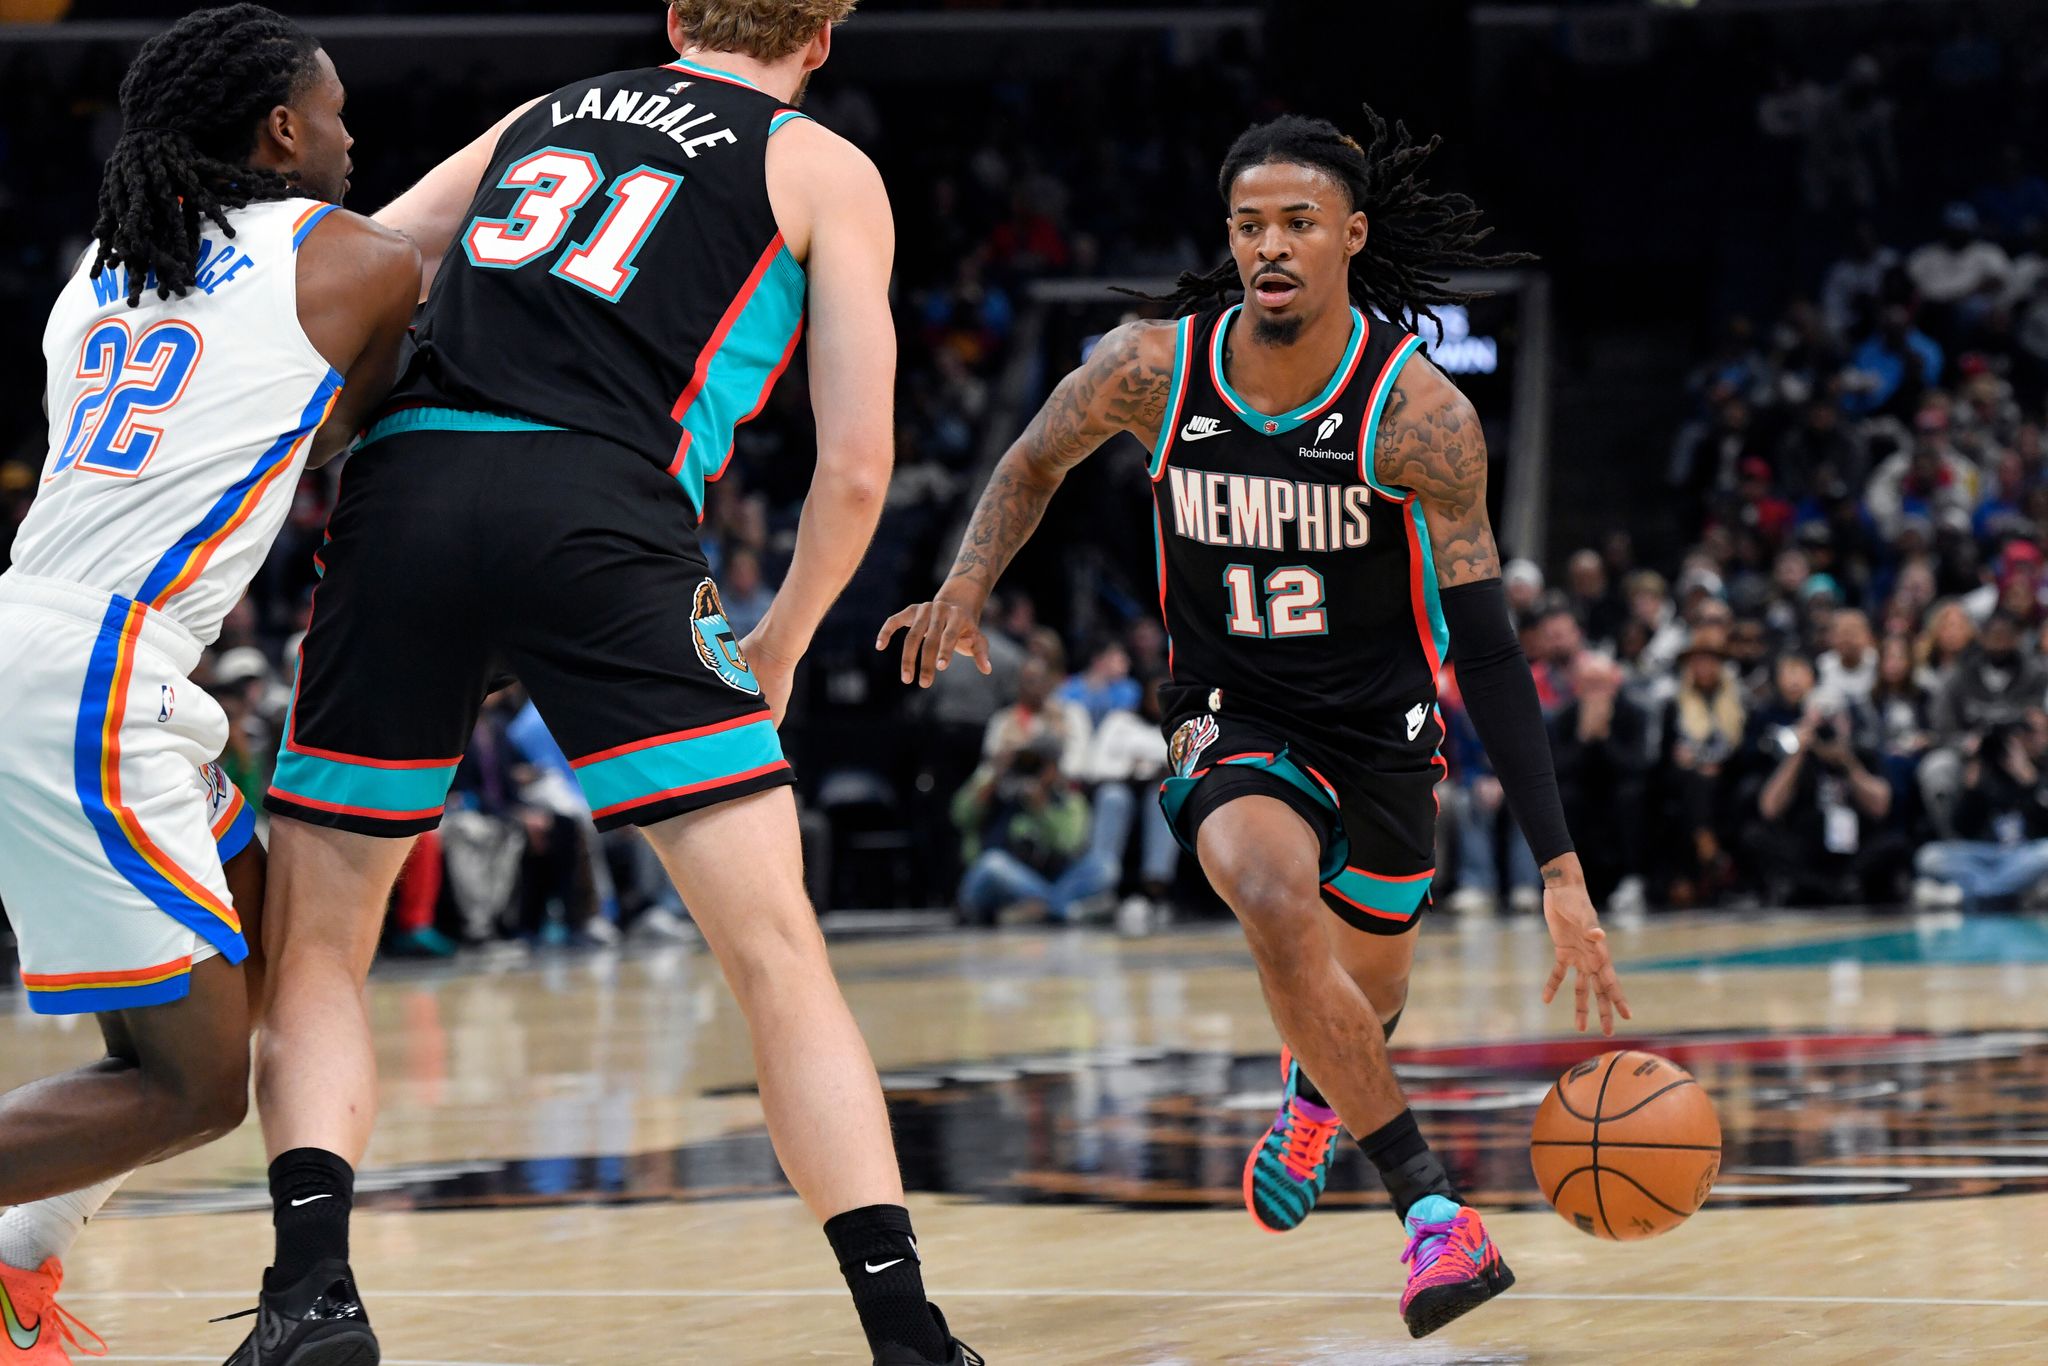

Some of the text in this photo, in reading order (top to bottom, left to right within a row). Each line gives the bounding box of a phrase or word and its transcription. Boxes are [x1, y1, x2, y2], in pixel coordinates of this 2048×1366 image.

[551, 88, 738, 158] LANDALE
[461, 145, 685, 304] 31
[43, 317, 204, 483] 22
[1187, 415, 1221, 433] NIKE
[1298, 447, 1354, 461] Robinhood
[1167, 464, 1372, 552] MEMPHIS
[1222, 563, 1329, 639] 12
